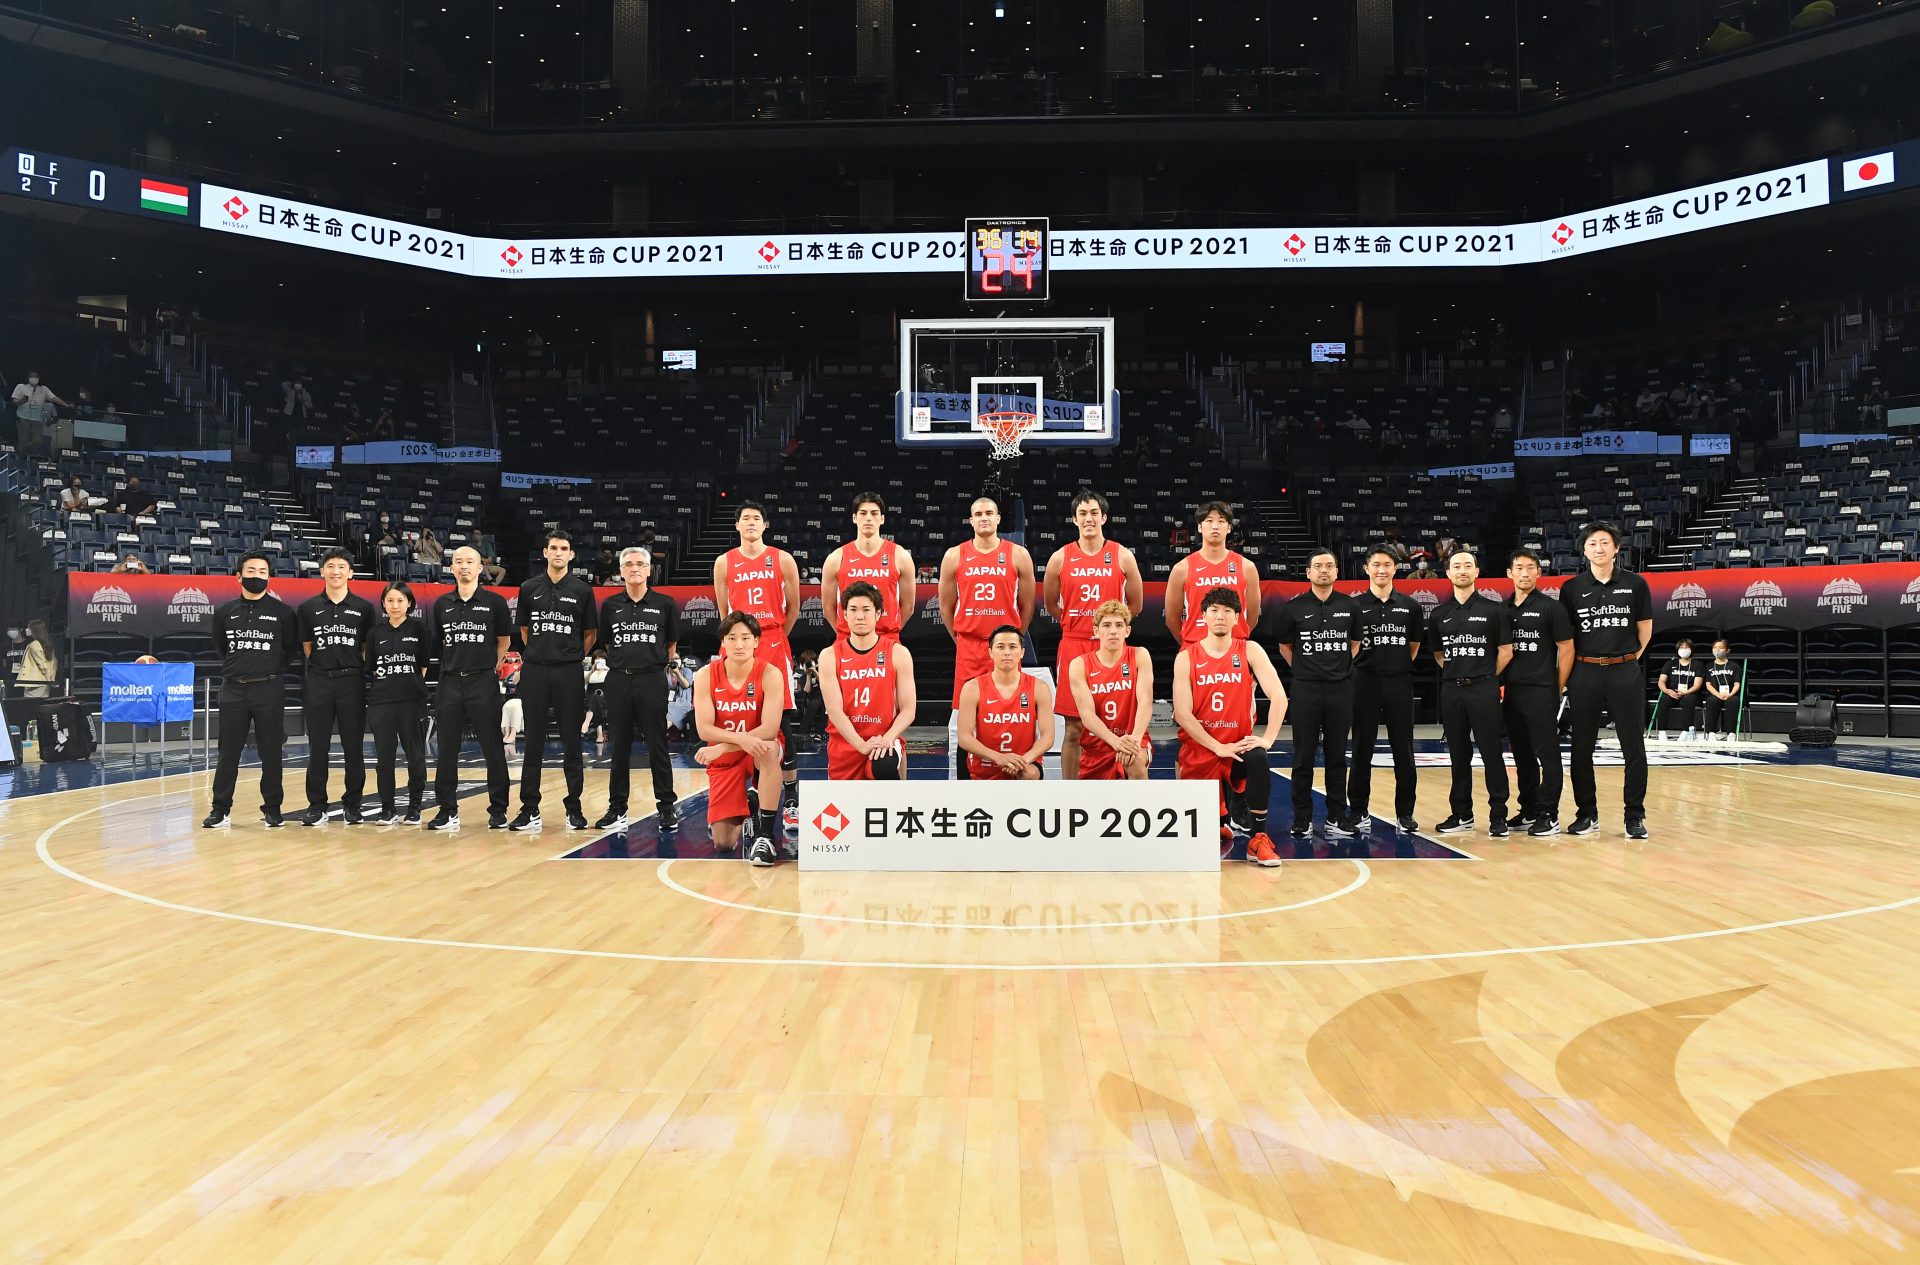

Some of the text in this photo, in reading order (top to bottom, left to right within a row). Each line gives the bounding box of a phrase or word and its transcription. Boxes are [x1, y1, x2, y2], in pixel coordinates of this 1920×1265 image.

[49, 162, 58, 176] F
[21, 177, 58, 195] 2 T
[89, 169, 106, 201] 0
[1582, 173, 1807, 239] 日本生命 CUP 2021
[222, 219, 249, 230] NISSAY
[259, 203, 466, 261] 日本生命 CUP 2021
[1050, 237, 1249, 258] 日本生命 CUP 2021
[1314, 233, 1514, 255] 日本生命 CUP 2021
[1552, 245, 1575, 254] NISSAY
[530, 244, 725, 265] 日本生命 CUP 2021
[787, 241, 864, 261] 日本生命
[871, 240, 920, 260] CUP
[734, 570, 774, 583] JAPAN
[848, 568, 890, 578] JAPAN
[965, 566, 1006, 576] JAPAN
[1070, 568, 1112, 577] JAPAN
[1195, 576, 1238, 586] JAPAN
[747, 587, 763, 605] 12
[974, 583, 995, 601] 23
[1080, 584, 1100, 602] 34
[1666, 598, 1712, 611] AKATSUKI
[1740, 597, 1787, 608] AKATSUKI
[1817, 594, 1868, 607] AKATSUKI
[86, 603, 137, 615] AKATSUKI
[167, 605, 215, 615] AKATSUKI
[680, 610, 719, 620] AKATSUKI
[974, 608, 1006, 616] SoftBank
[1590, 604, 1631, 616] SoftBank
[1679, 608, 1698, 617] FIVE
[1754, 606, 1773, 615] FIVE
[1832, 604, 1852, 614] FIVE
[102, 613, 122, 622] FIVE
[182, 613, 200, 623] FIVE
[540, 611, 574, 623] SoftBank
[691, 618, 707, 626] FIVE
[1593, 617, 1629, 628] 日本生命
[323, 624, 357, 635] SoftBank
[451, 621, 487, 631] SoftBank
[541, 622, 572, 635] 日本生命
[620, 621, 658, 632] SoftBank
[1370, 623, 1407, 634] SoftBank
[235, 629, 275, 640] SoftBank
[623, 633, 656, 644] 日本生命
[1373, 635, 1407, 646] 日本生命
[1449, 633, 1488, 645] SoftBank
[237, 641, 271, 651] 日本生命
[1452, 646, 1486, 657] 日本生命
[840, 668, 886, 680] JAPAN
[1196, 672, 1242, 686] JAPAN
[1671, 669, 1695, 677] JAPAN
[110, 684, 152, 696] molten
[167, 683, 194, 695] molten
[1091, 679, 1132, 694] JAPAN
[854, 687, 870, 708] 14
[1211, 692, 1224, 712] 6
[716, 700, 757, 712] JAPAN
[1104, 700, 1117, 721] 9
[983, 712, 1030, 724] JAPAN
[1000, 732, 1013, 752] 2
[864, 806, 1199, 840] 日本生命 CUP 2021
[812, 844, 850, 853] NISSAY
